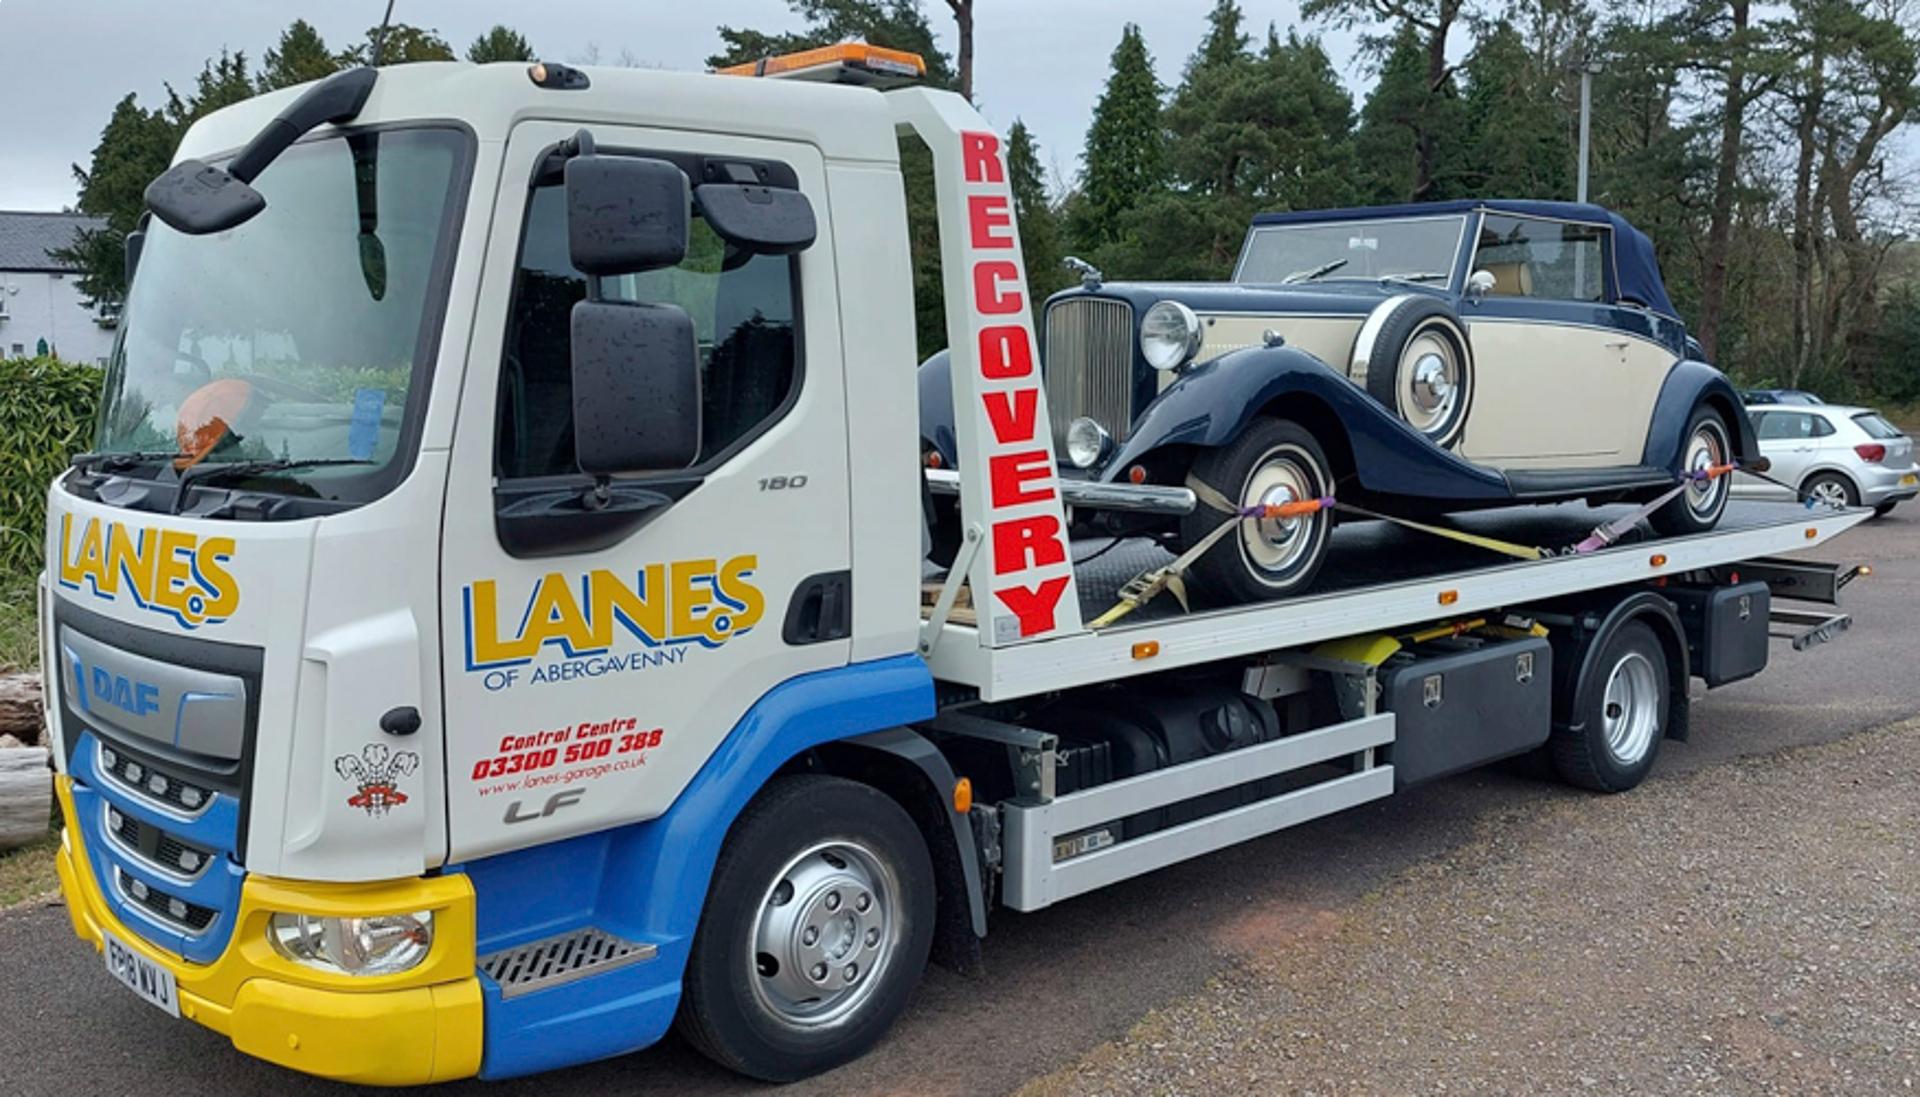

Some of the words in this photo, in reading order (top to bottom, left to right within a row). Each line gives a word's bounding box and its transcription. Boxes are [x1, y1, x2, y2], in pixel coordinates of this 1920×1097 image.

[960, 130, 1071, 638] RECOVERY
[757, 475, 808, 491] 180
[59, 512, 240, 629] LANES
[463, 554, 765, 671] LANES
[92, 666, 160, 717] DAF
[484, 669, 519, 691] OF
[530, 646, 688, 685] ABERGAVENNY
[472, 748, 558, 781] 03300
[564, 738, 613, 764] 500
[618, 728, 664, 753] 388
[500, 726, 572, 753] Control
[577, 717, 637, 740] Centre
[480, 753, 648, 797] www.lanes-garage.co.uk
[503, 787, 587, 825] LF
